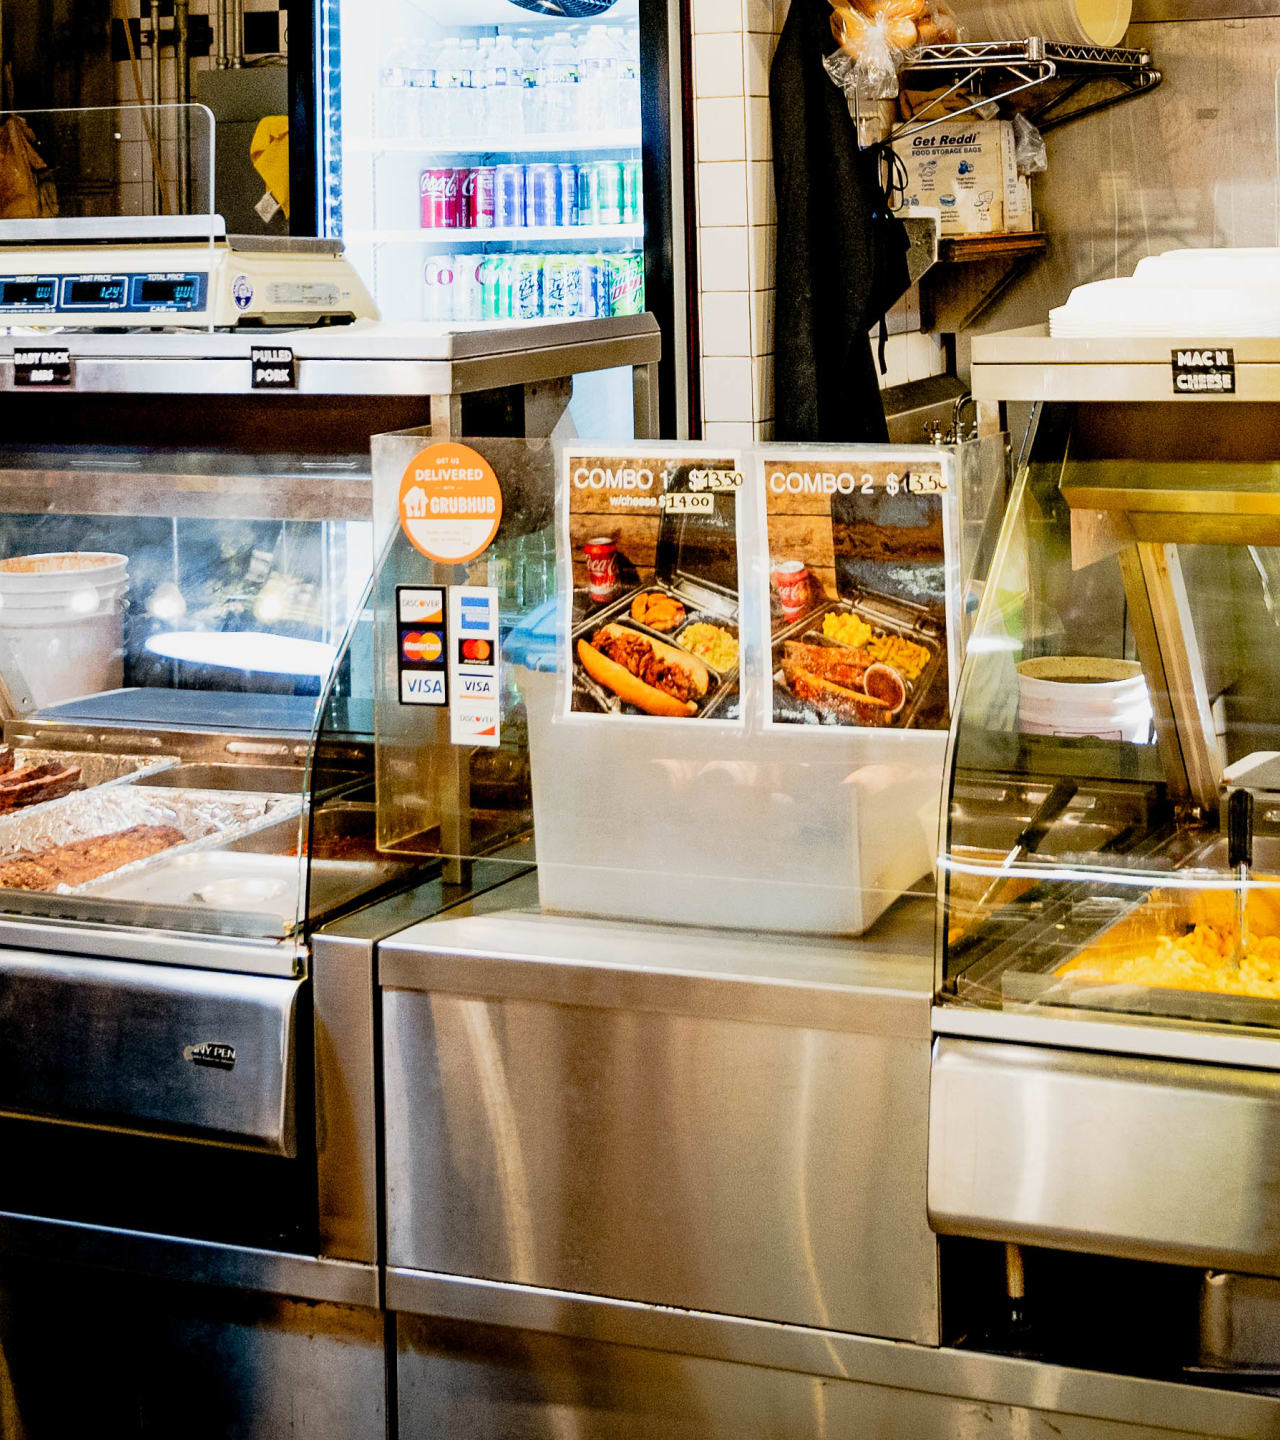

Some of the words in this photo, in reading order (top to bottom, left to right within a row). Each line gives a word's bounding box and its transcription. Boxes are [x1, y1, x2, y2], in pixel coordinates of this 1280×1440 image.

[912, 136, 936, 147] Get
[939, 133, 978, 146] Reddi
[912, 149, 932, 157] FOOD
[931, 148, 962, 156] STORAGE
[252, 350, 292, 362] PULLED
[1177, 351, 1214, 366] MAC
[1215, 350, 1228, 366] N
[256, 369, 290, 382] PORK
[1176, 373, 1232, 390] CHEESE
[415, 468, 484, 481] DELIVERED
[573, 468, 654, 490] COMBO
[659, 469, 669, 490] 1
[769, 471, 855, 495] COMBO
[861, 472, 874, 495] 2
[430, 496, 496, 514] GRUBHUB
[402, 598, 441, 608] DISCOVER
[407, 678, 443, 694] VISA
[464, 680, 490, 692] VISA
